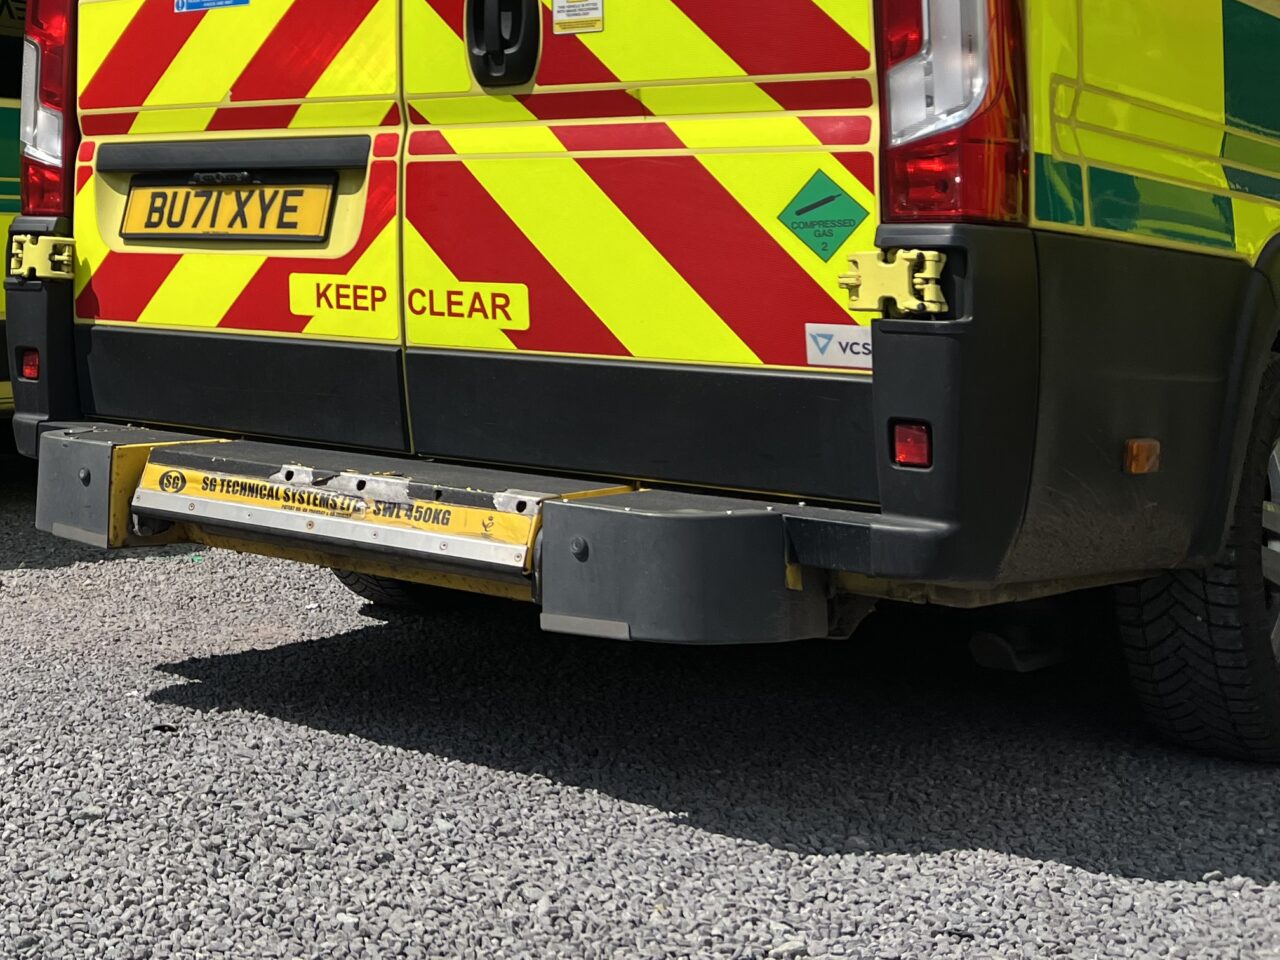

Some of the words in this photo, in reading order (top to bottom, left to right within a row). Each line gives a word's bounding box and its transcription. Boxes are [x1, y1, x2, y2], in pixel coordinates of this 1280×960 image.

[144, 190, 222, 229] BU71
[227, 189, 304, 229] XYE
[791, 218, 856, 231] COMPRESSED
[814, 229, 834, 238] GAS
[821, 242, 828, 251] 2
[316, 283, 386, 311] KEEP
[408, 288, 512, 321] CLEAR
[838, 341, 872, 356] VCS
[163, 474, 181, 489] SG
[202, 476, 217, 491] SG
[219, 478, 281, 501] TECHNICAL
[282, 484, 339, 510] SYSTEMS
